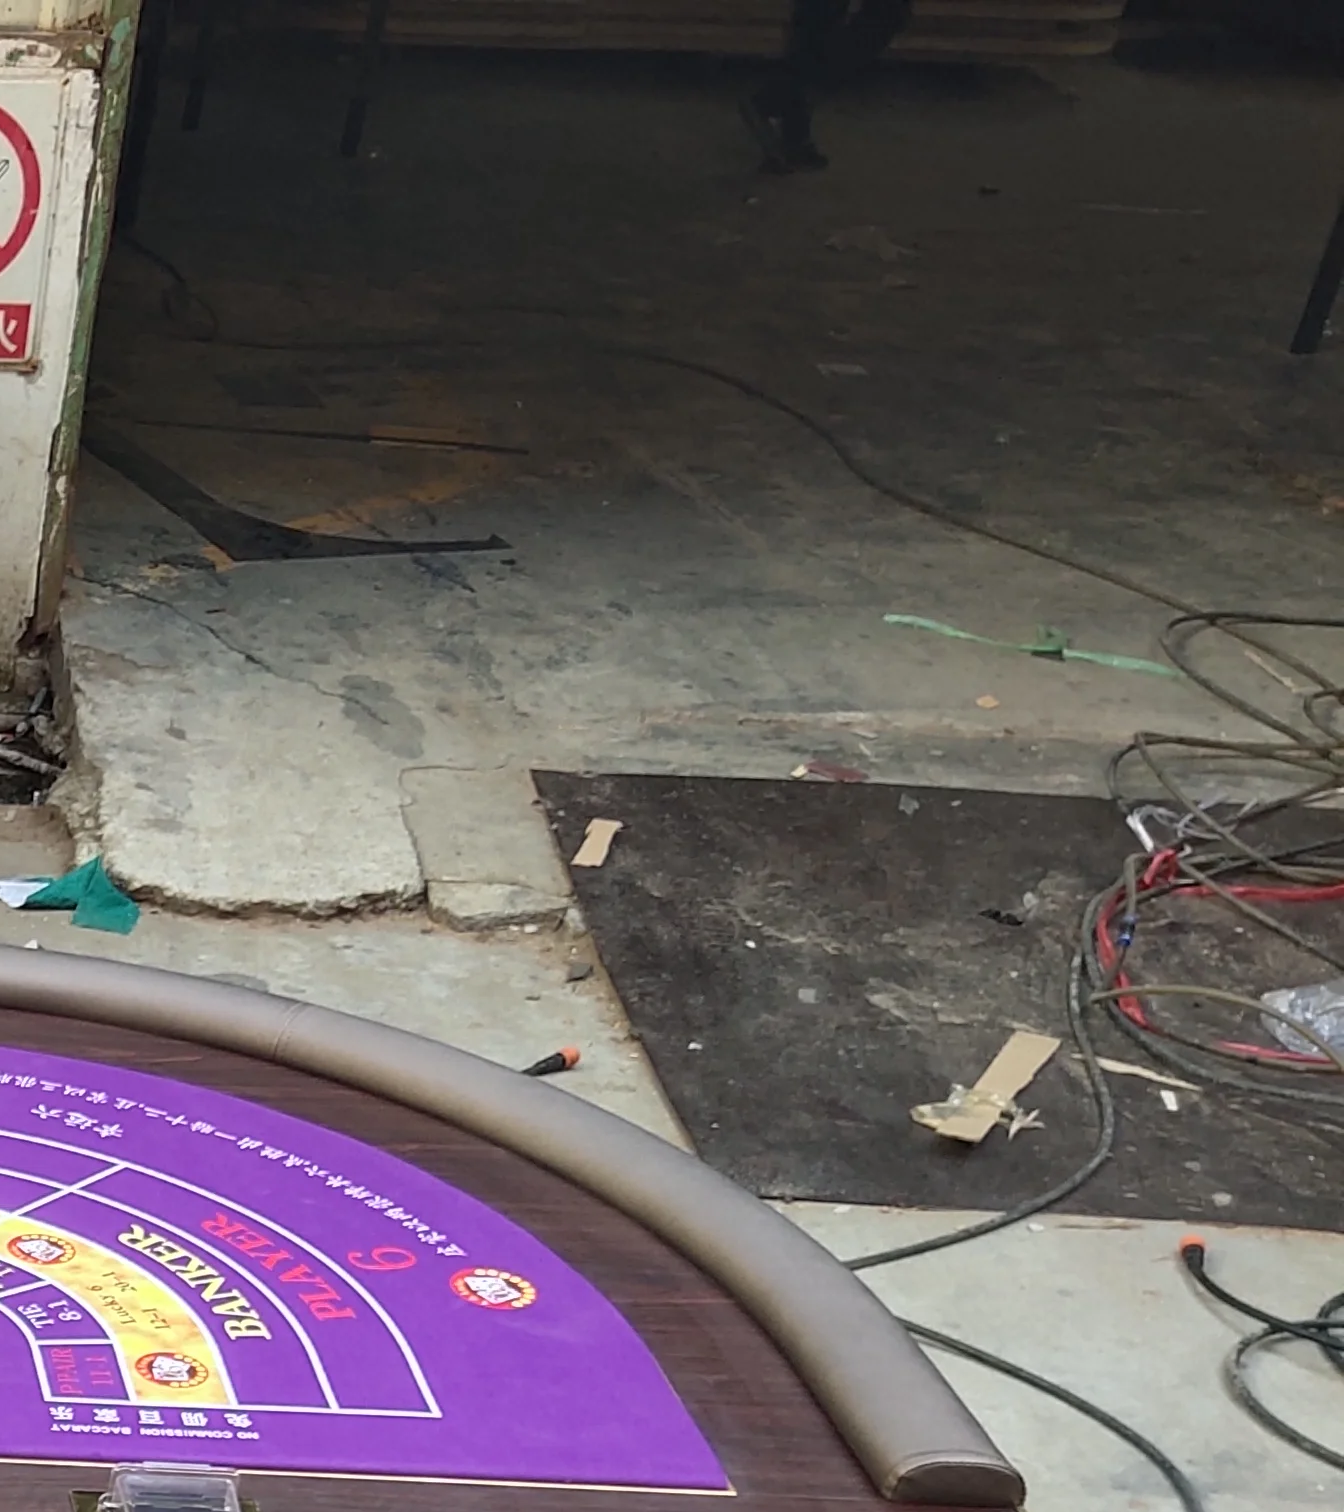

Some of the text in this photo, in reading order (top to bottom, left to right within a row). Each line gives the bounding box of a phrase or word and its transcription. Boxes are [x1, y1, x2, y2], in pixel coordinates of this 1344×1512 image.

[30, 1103, 124, 1139] 幸运六
[200, 1212, 357, 1322] PLAYER
[347, 1247, 417, 1271] 6
[117, 1223, 272, 1341] BANKER
[17, 1303, 55, 1330] TIE
[47, 1300, 83, 1322] 8-1
[99, 1293, 137, 1326] Lucky
[50, 1423, 260, 1440] NO COMMISSION BACCARAT
